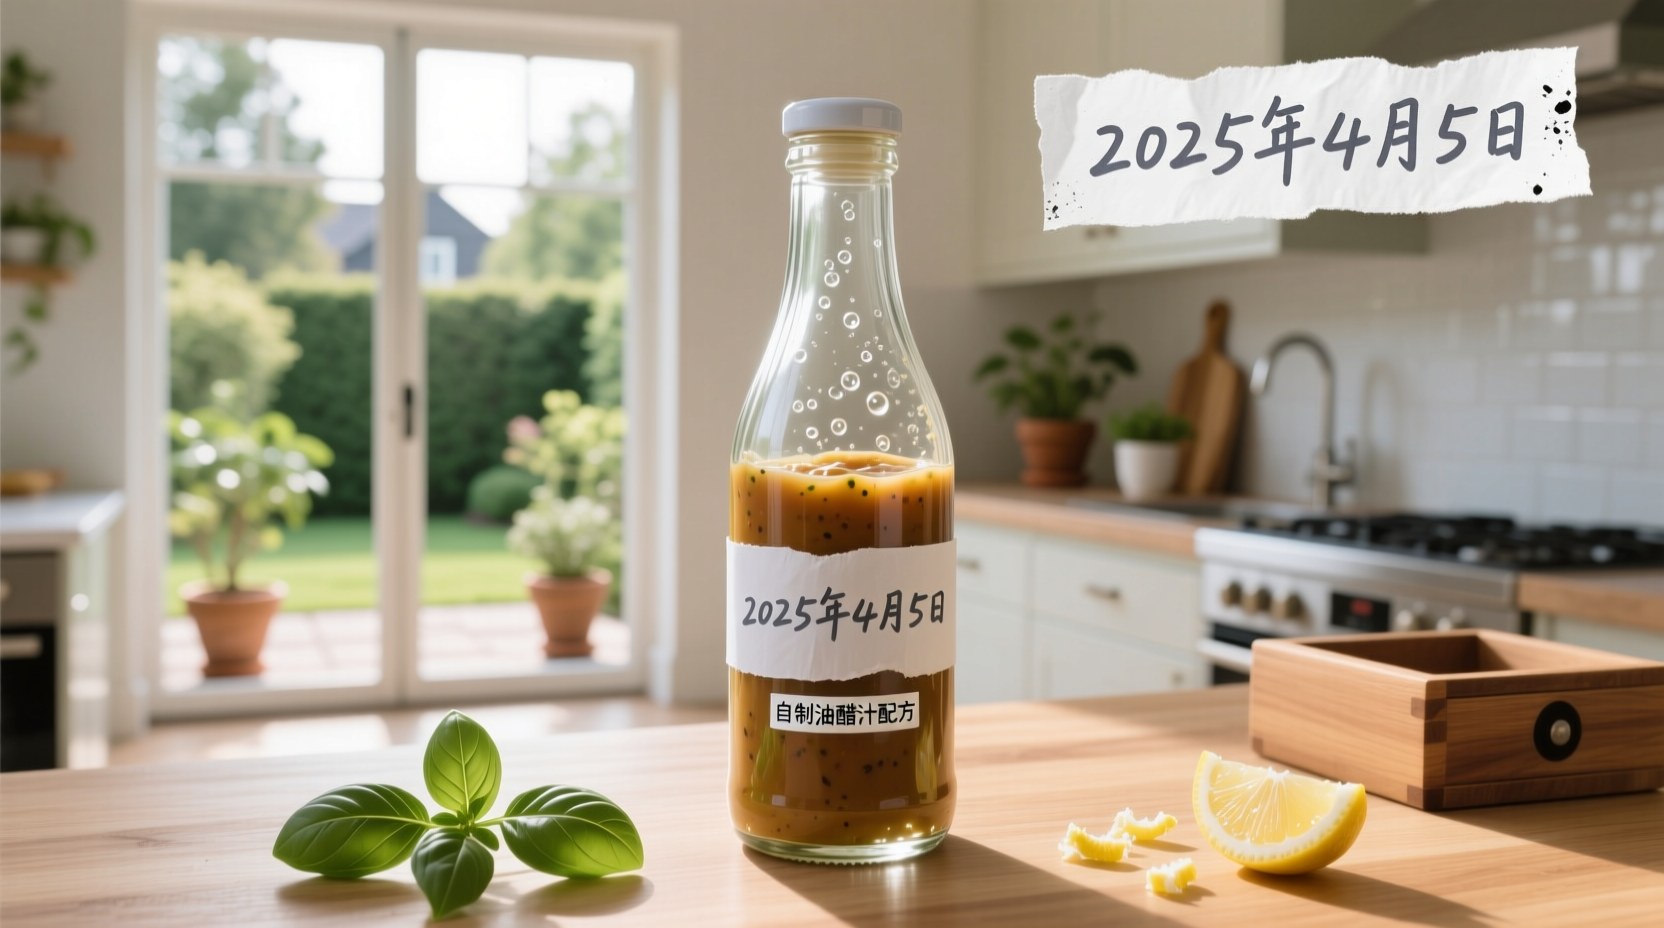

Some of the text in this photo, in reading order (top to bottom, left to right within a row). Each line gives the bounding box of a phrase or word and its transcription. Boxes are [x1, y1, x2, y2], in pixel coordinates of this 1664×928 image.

[742, 586, 945, 643] 2025年4月5日
[776, 700, 916, 726] 自制油醋汁配方
